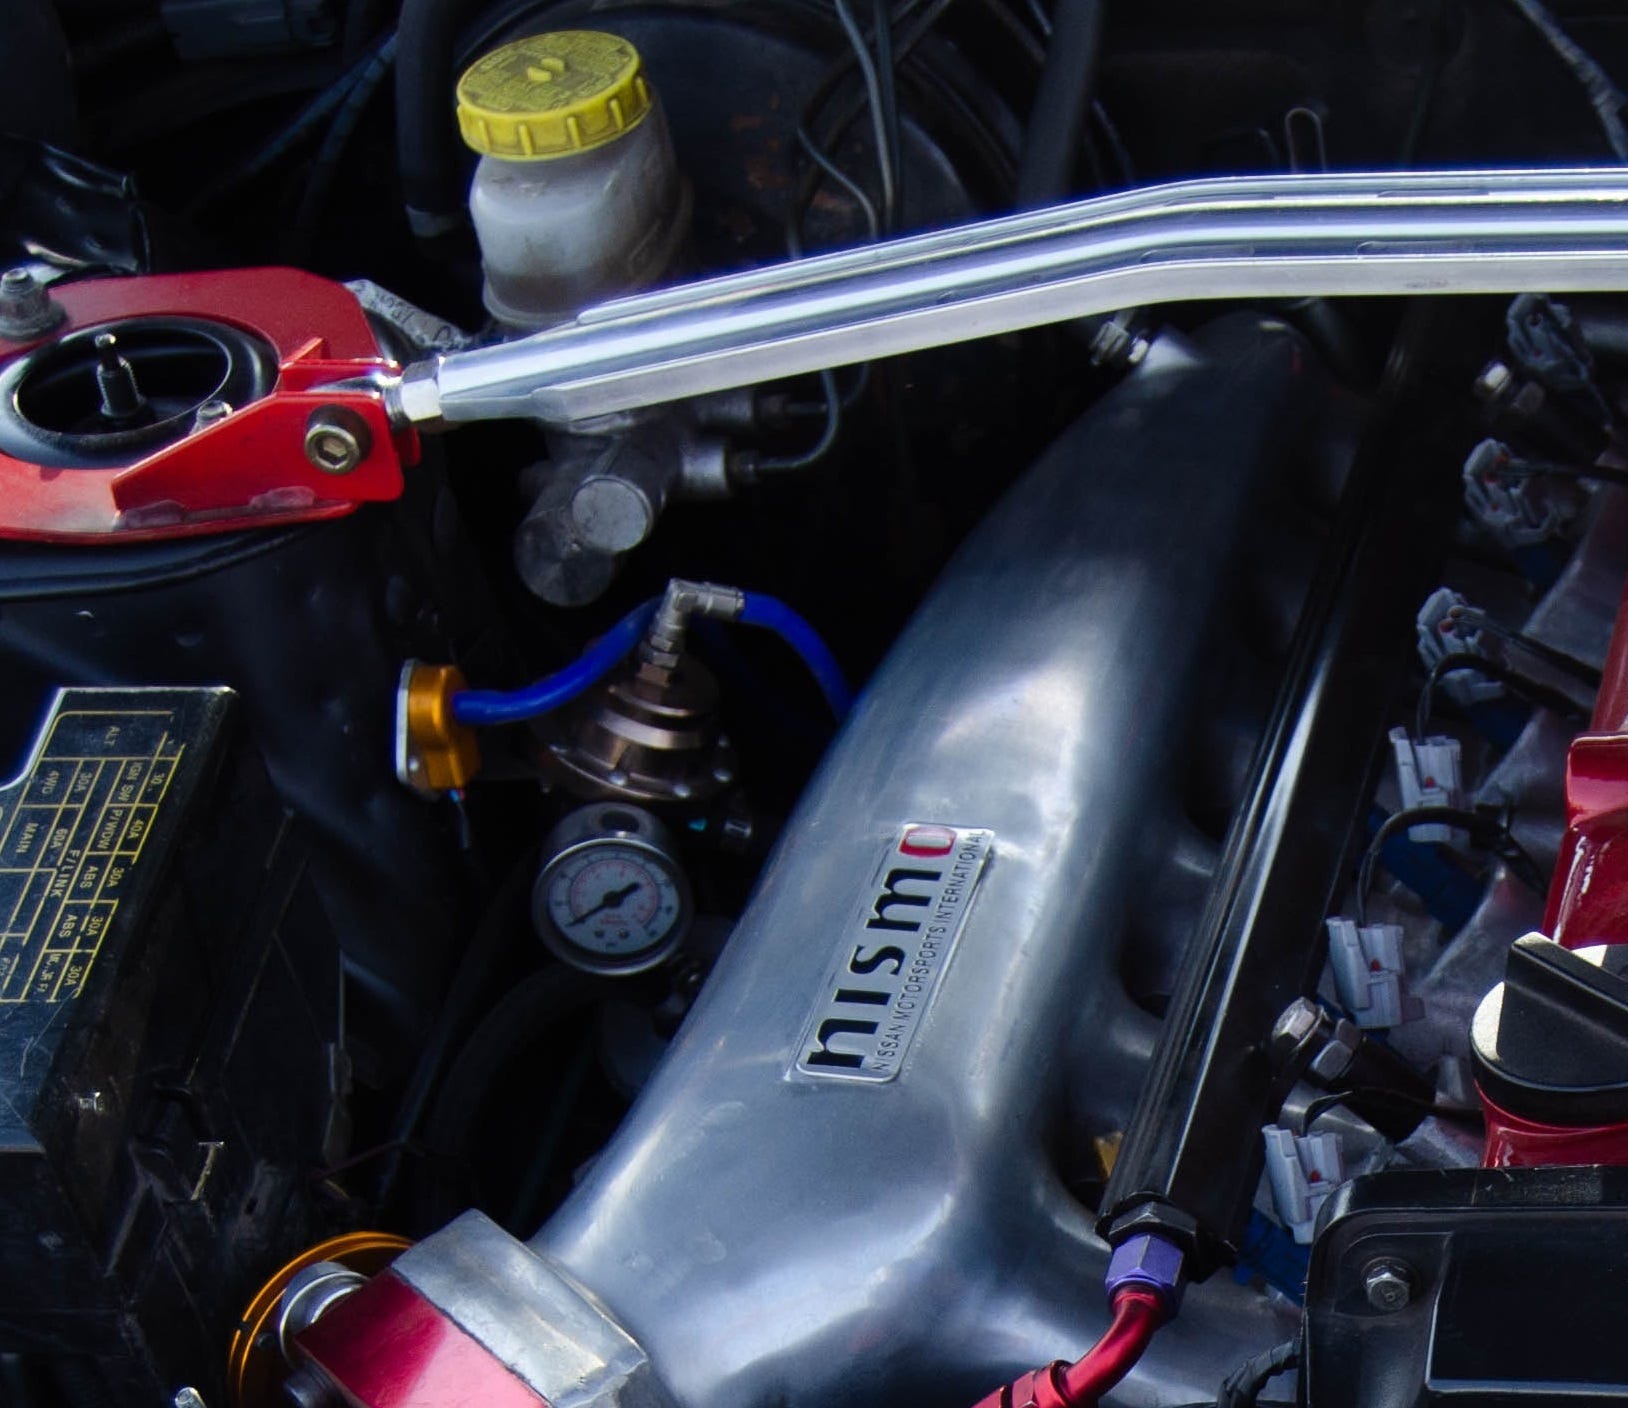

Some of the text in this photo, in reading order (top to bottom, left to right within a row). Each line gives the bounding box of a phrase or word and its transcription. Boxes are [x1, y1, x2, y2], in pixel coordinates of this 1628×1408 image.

[75, 772, 93, 792] 30A
[118, 762, 143, 801] IGN SW
[15, 822, 39, 853] MAIN
[97, 809, 123, 849] P/WDW
[128, 819, 144, 839] 40A
[50, 849, 80, 898] F/LINK
[80, 865, 99, 889] ABS
[107, 866, 124, 887] 30A
[58, 913, 78, 938] ABS
[86, 915, 103, 936] 30A
[806, 826, 957, 1068] nismo
[873, 830, 987, 1071] NISSAN MOTORSPORTS INTERNATIONAL
[65, 965, 82, 986] 30A
